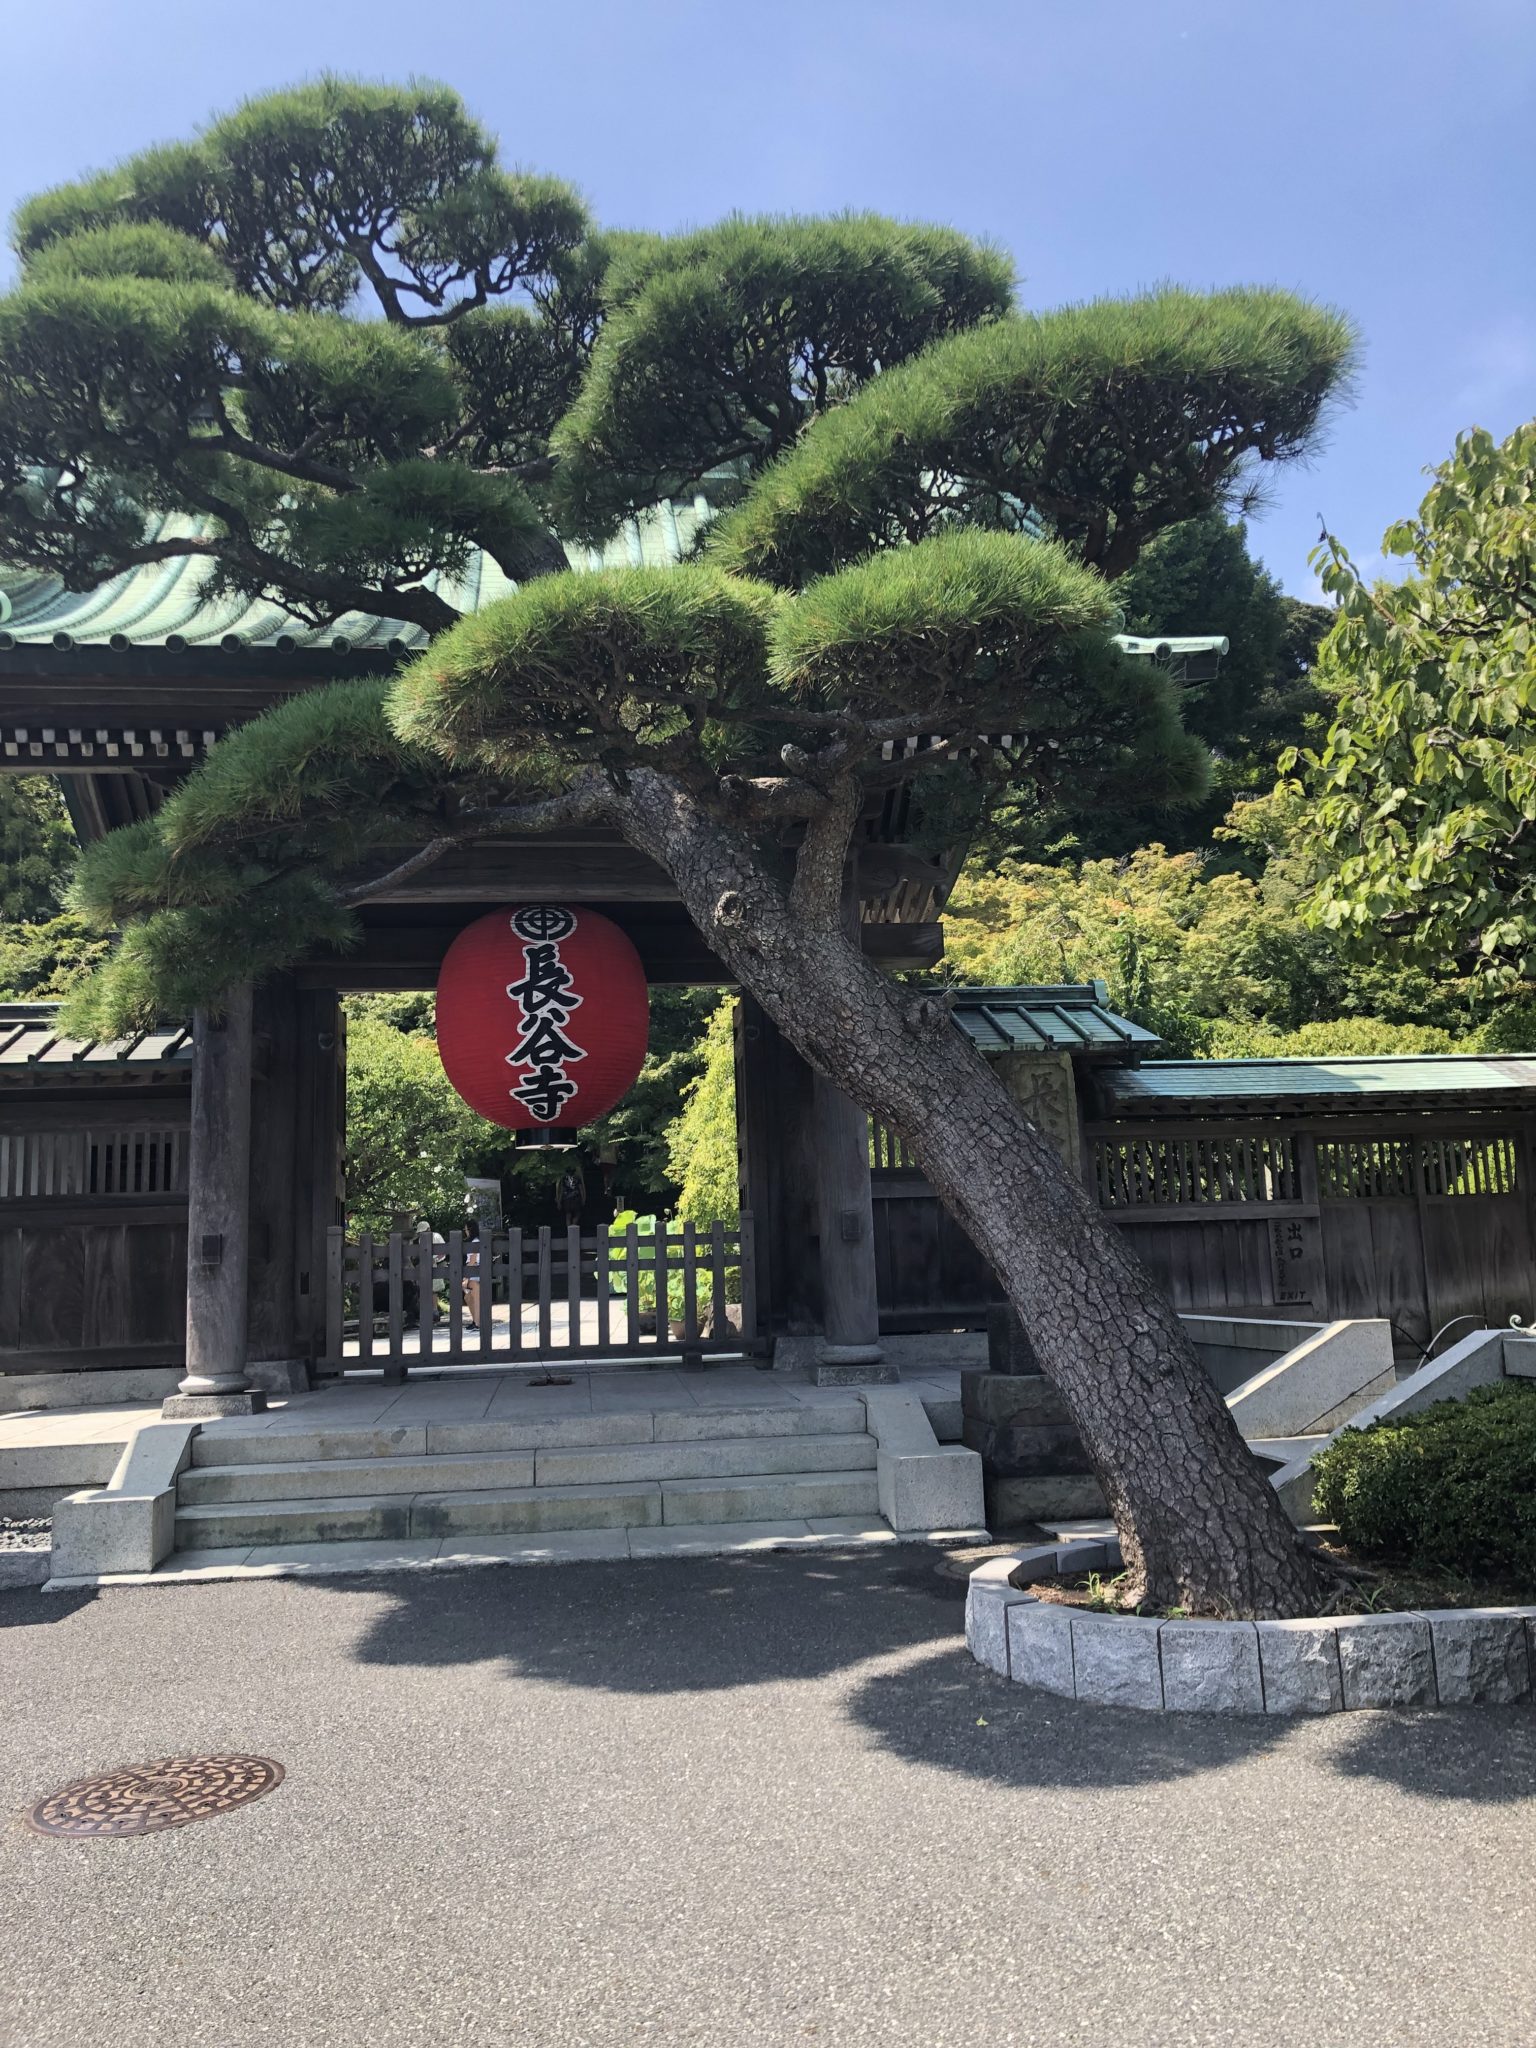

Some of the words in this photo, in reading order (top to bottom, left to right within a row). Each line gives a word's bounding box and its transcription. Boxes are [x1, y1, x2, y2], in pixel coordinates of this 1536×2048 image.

[506, 941, 588, 1121] 長谷寺
[1287, 1222, 1303, 1260] 出口
[1280, 1291, 1306, 1301] EXIT
